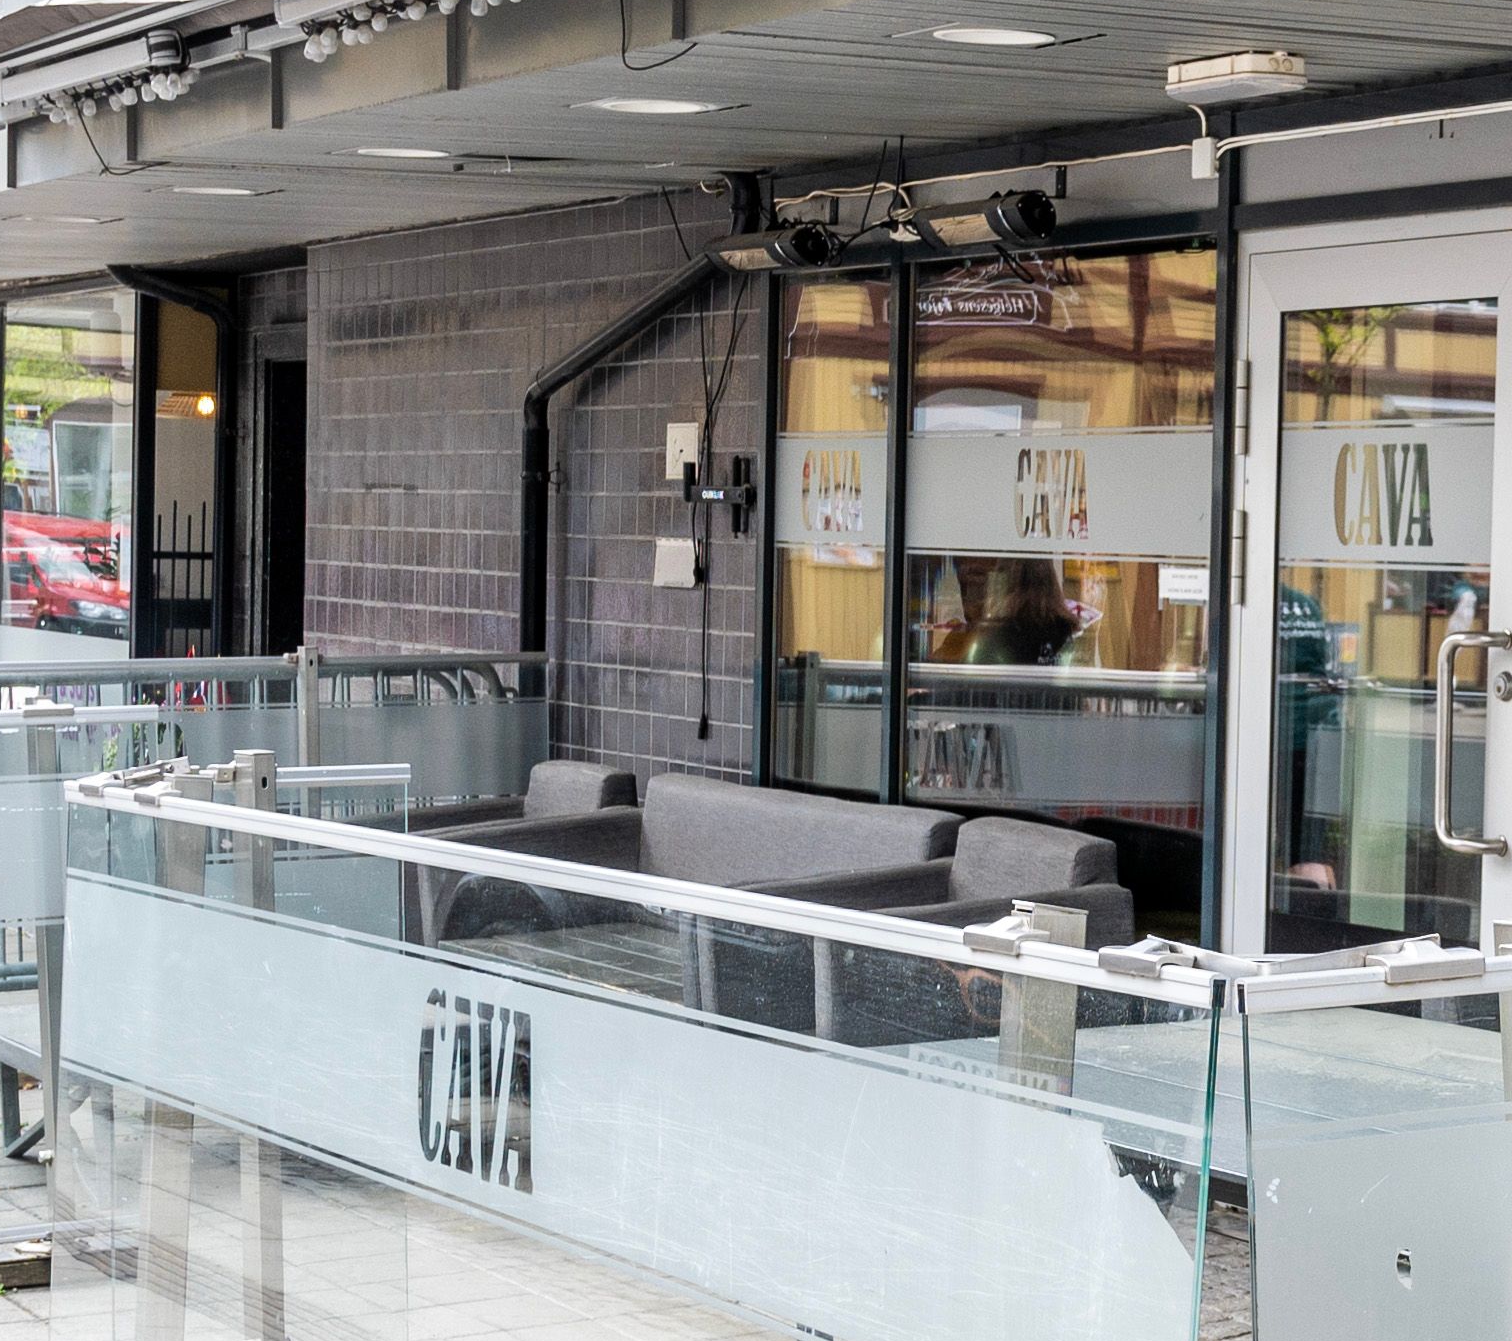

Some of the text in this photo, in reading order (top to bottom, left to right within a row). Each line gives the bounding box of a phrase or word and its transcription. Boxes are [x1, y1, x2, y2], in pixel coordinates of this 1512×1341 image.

[801, 448, 864, 533] CAVA
[1014, 447, 1090, 541] CAVA
[1334, 442, 1434, 548] CAVA
[417, 988, 537, 1195] CAVA
